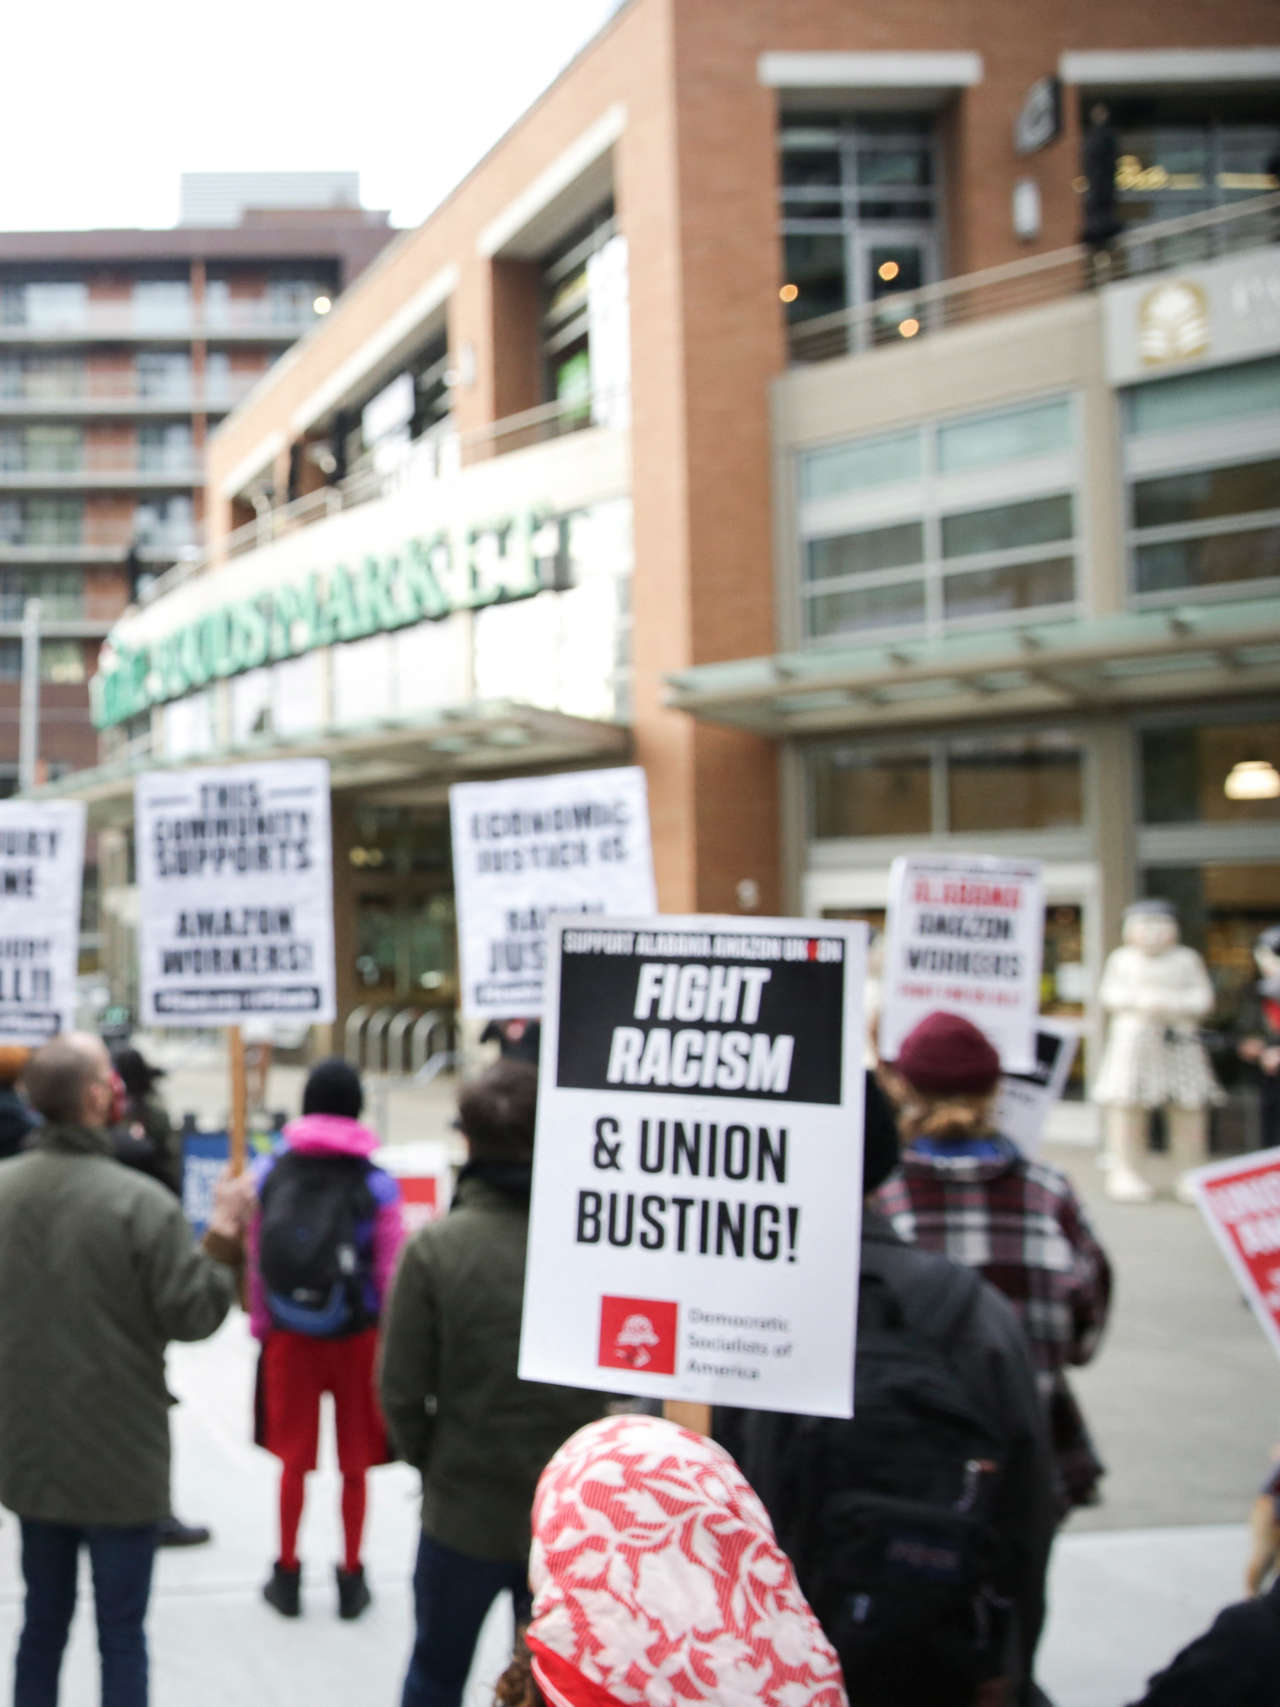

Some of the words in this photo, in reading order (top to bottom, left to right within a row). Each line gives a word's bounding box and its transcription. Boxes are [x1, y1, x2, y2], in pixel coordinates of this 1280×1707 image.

[200, 782, 260, 810] THIS
[156, 810, 310, 842] COMMUNITY
[157, 841, 311, 877] SUPPORTS
[176, 907, 294, 938] AMAZON
[634, 963, 772, 1024] FIGHT
[606, 1026, 795, 1093] RACISM
[593, 1117, 622, 1171] &
[639, 1119, 787, 1183] UNION
[576, 1190, 800, 1263] BUSTING!
[688, 1308, 789, 1332] Democratic
[687, 1334, 769, 1356] Socialists
[773, 1343, 794, 1358] of
[686, 1360, 761, 1380] America
